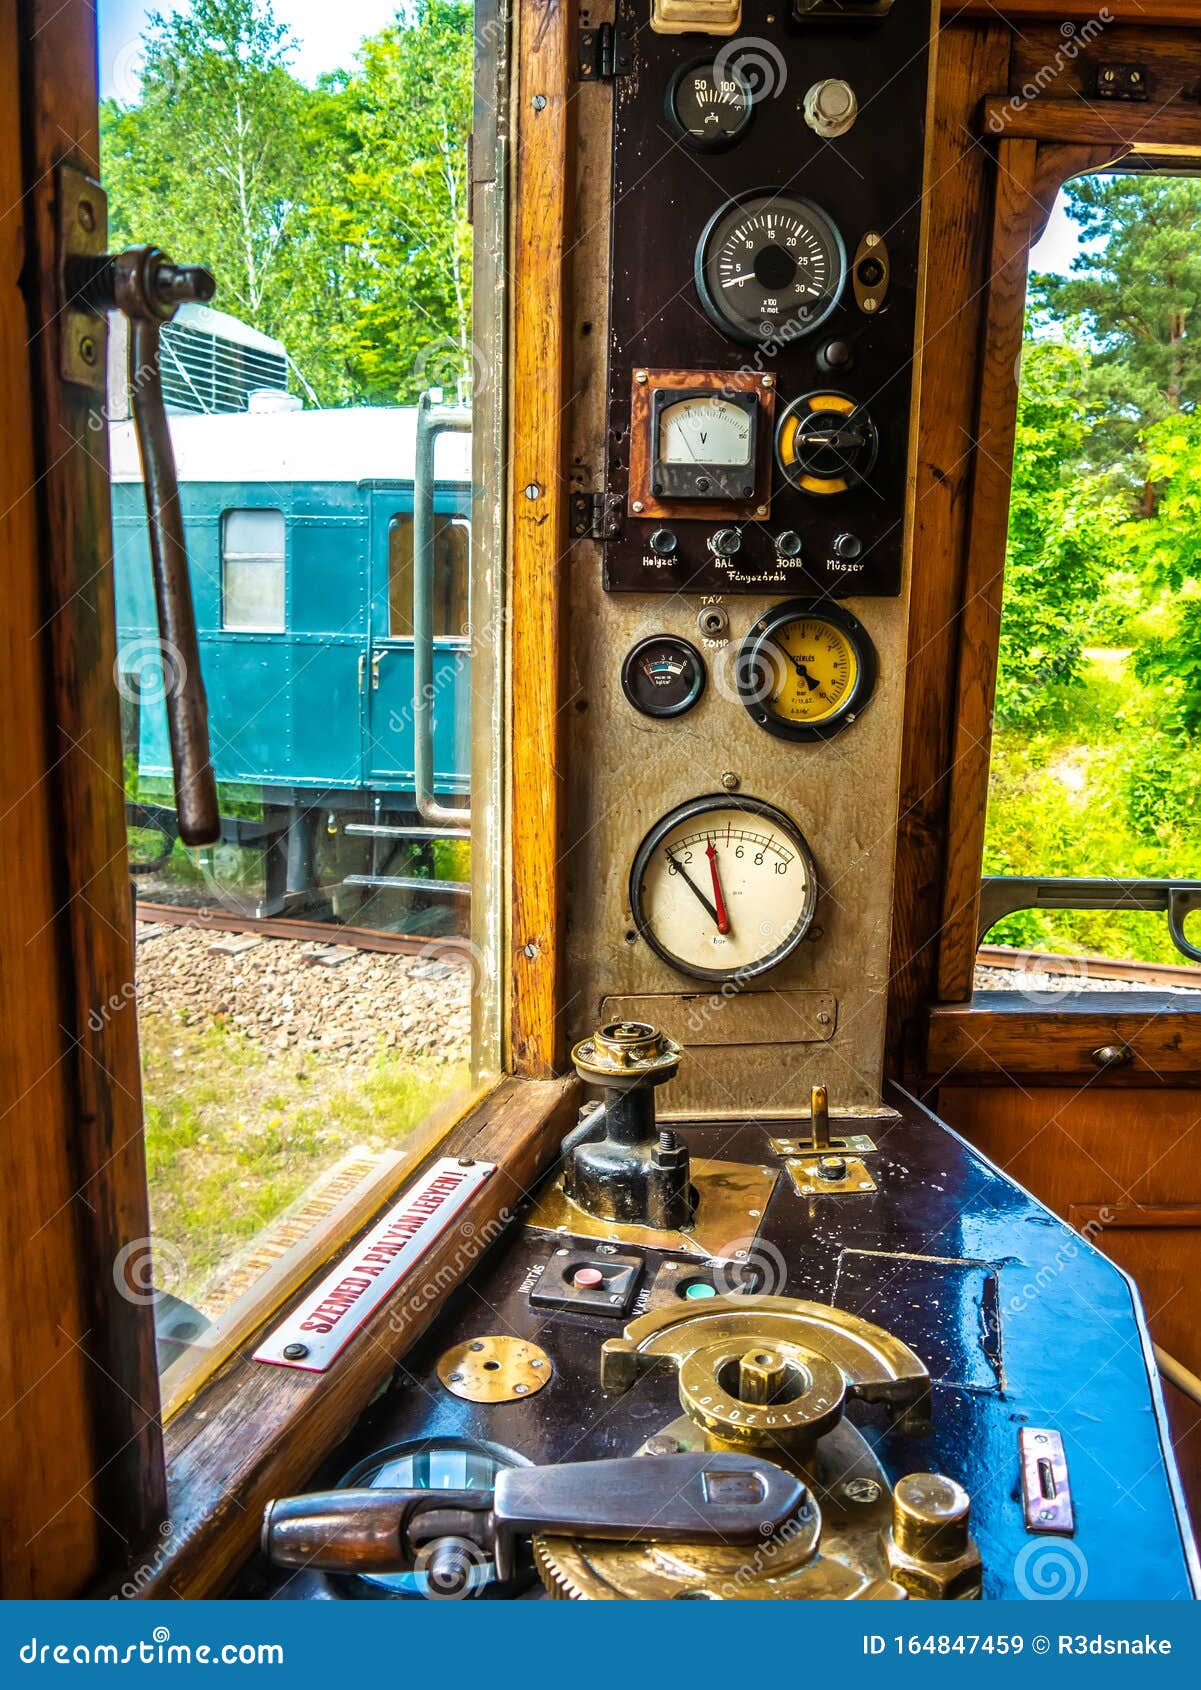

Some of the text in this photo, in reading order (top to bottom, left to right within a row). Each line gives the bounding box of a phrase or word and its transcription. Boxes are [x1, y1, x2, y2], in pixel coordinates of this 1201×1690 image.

[694, 79, 736, 92] 50 100
[767, 230, 776, 239] 15
[745, 240, 754, 249] 10
[786, 237, 797, 246] 20
[798, 256, 808, 265] 25
[735, 263, 741, 272] 5
[794, 284, 805, 293] 30
[700, 432, 707, 444] V
[714, 558, 734, 568] BAL
[776, 558, 803, 568] JOBB
[684, 851, 693, 864] 2
[735, 846, 744, 858] 6
[754, 852, 764, 865] 8
[774, 862, 788, 875] 10
[414, 1176, 462, 1215] LEGYEN
[367, 1213, 428, 1264] PÁLYÁN
[362, 1259, 386, 1277] A
[299, 1276, 372, 1334] SZEMED
